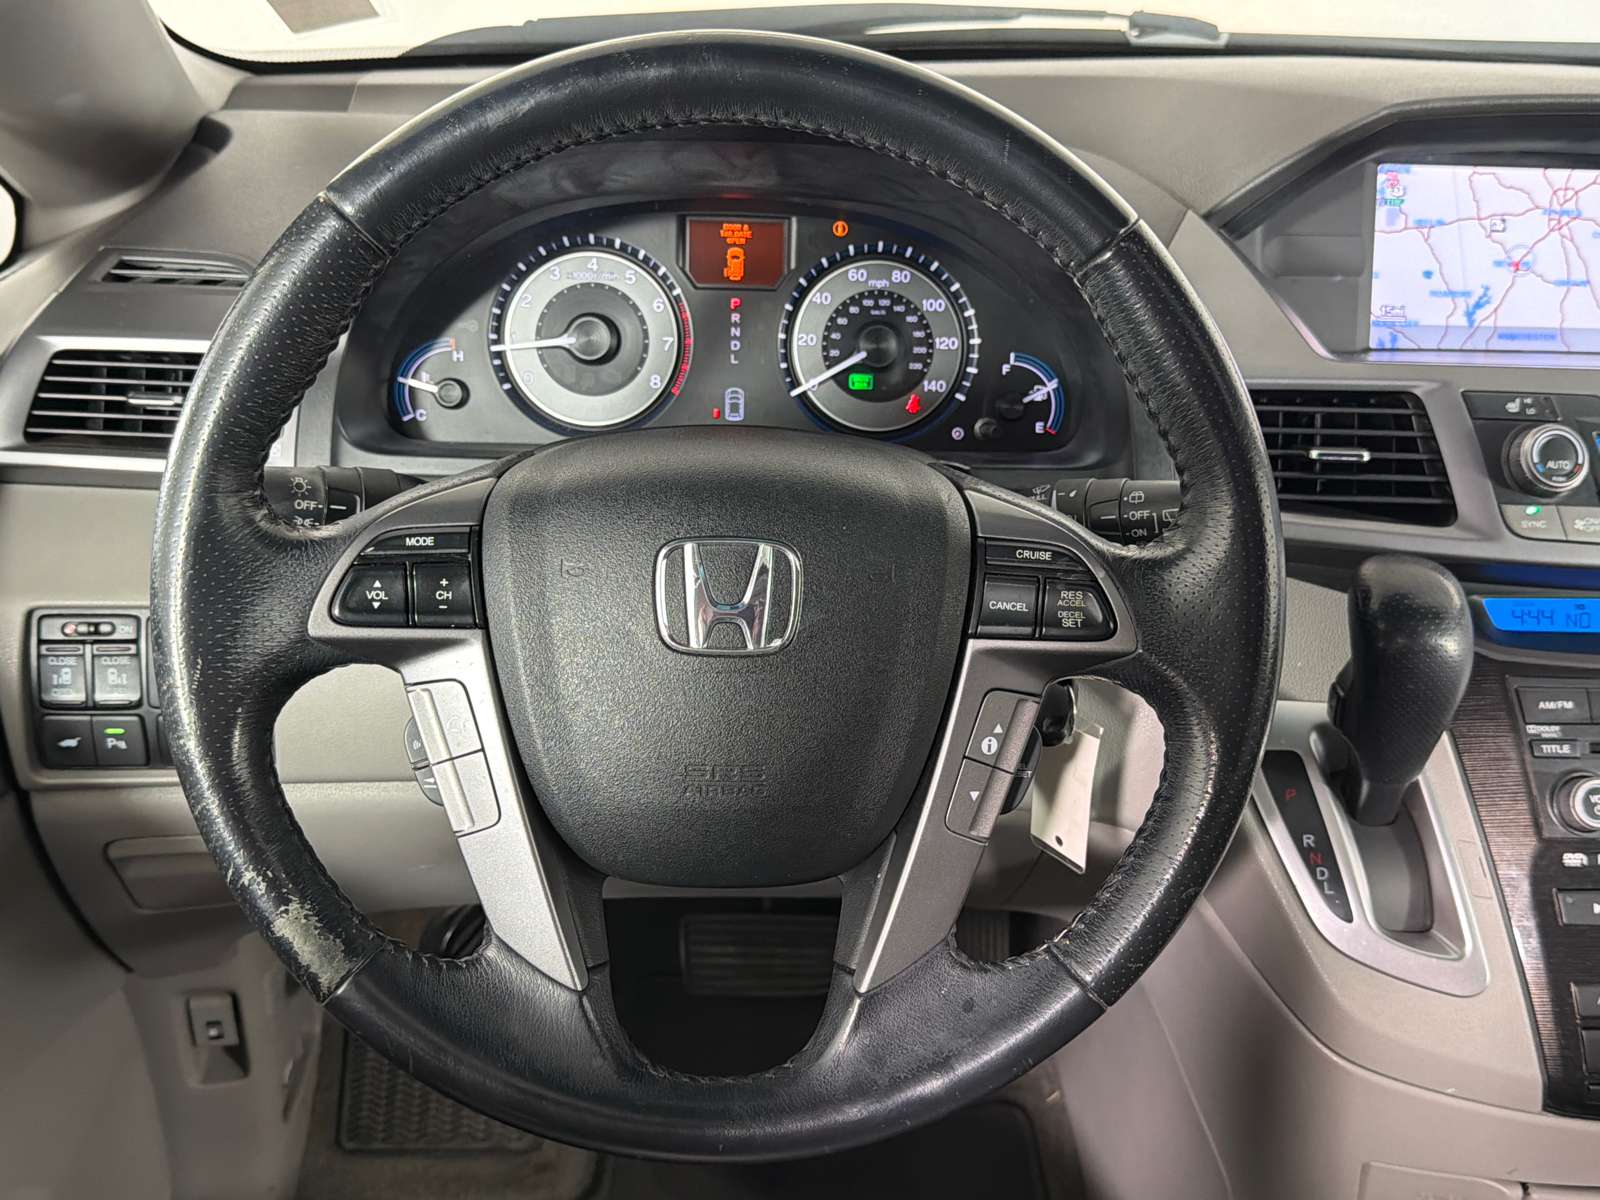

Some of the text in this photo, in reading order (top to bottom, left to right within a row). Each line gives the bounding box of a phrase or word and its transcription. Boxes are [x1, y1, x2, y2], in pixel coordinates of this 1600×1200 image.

[587, 258, 598, 271] 4
[549, 267, 560, 281] 3
[624, 270, 636, 284] 5
[848, 269, 867, 282] 60
[891, 270, 911, 284] 80
[868, 279, 889, 290] mph
[521, 294, 532, 308] 2
[730, 297, 742, 310] P
[812, 292, 831, 305] 40
[862, 299, 874, 307] 100
[878, 299, 891, 307] 120
[652, 298, 664, 312] 6
[849, 306, 860, 314] 80
[893, 305, 905, 313] 140
[922, 299, 945, 312] 100
[730, 313, 741, 324] R
[837, 317, 848, 325] 60
[730, 327, 741, 337] N
[830, 332, 841, 340] 40
[662, 337, 674, 351] 7
[798, 334, 817, 346] 20
[935, 337, 958, 350] 120
[730, 341, 741, 351] D
[452, 351, 463, 361] H
[730, 354, 739, 364] L
[1002, 364, 1011, 375] F
[522, 373, 533, 385] 0
[650, 375, 661, 389] 8
[923, 380, 946, 392] 140
[415, 409, 427, 421] C
[1035, 422, 1045, 434] E
[1546, 460, 1570, 469] AUTO
[294, 499, 318, 510] OFF
[1129, 510, 1150, 520] OFF
[1521, 520, 1546, 528] SYNC
[1131, 529, 1147, 537] ON
[406, 537, 435, 546] MODE
[1016, 550, 1052, 561] CRUISE
[366, 591, 388, 600] VOL
[436, 591, 452, 600] CH
[1060, 591, 1083, 599] RES
[989, 601, 1029, 612] CANCEL
[1057, 611, 1086, 619] DECEL
[1511, 609, 1554, 626] 4:44
[1061, 619, 1082, 628] SET
[119, 625, 133, 634] ON
[48, 656, 77, 666] CLOSE
[101, 656, 131, 665] CLOSE
[1538, 700, 1573, 710] AM/FM
[1540, 744, 1571, 754] TITLE
[685, 765, 766, 781] SRS
[683, 784, 766, 798] AIRBAG
[1285, 789, 1297, 801] P
[1303, 834, 1315, 848] R
[1310, 853, 1322, 865] N
[1316, 867, 1329, 880] D
[1324, 881, 1335, 894] L
